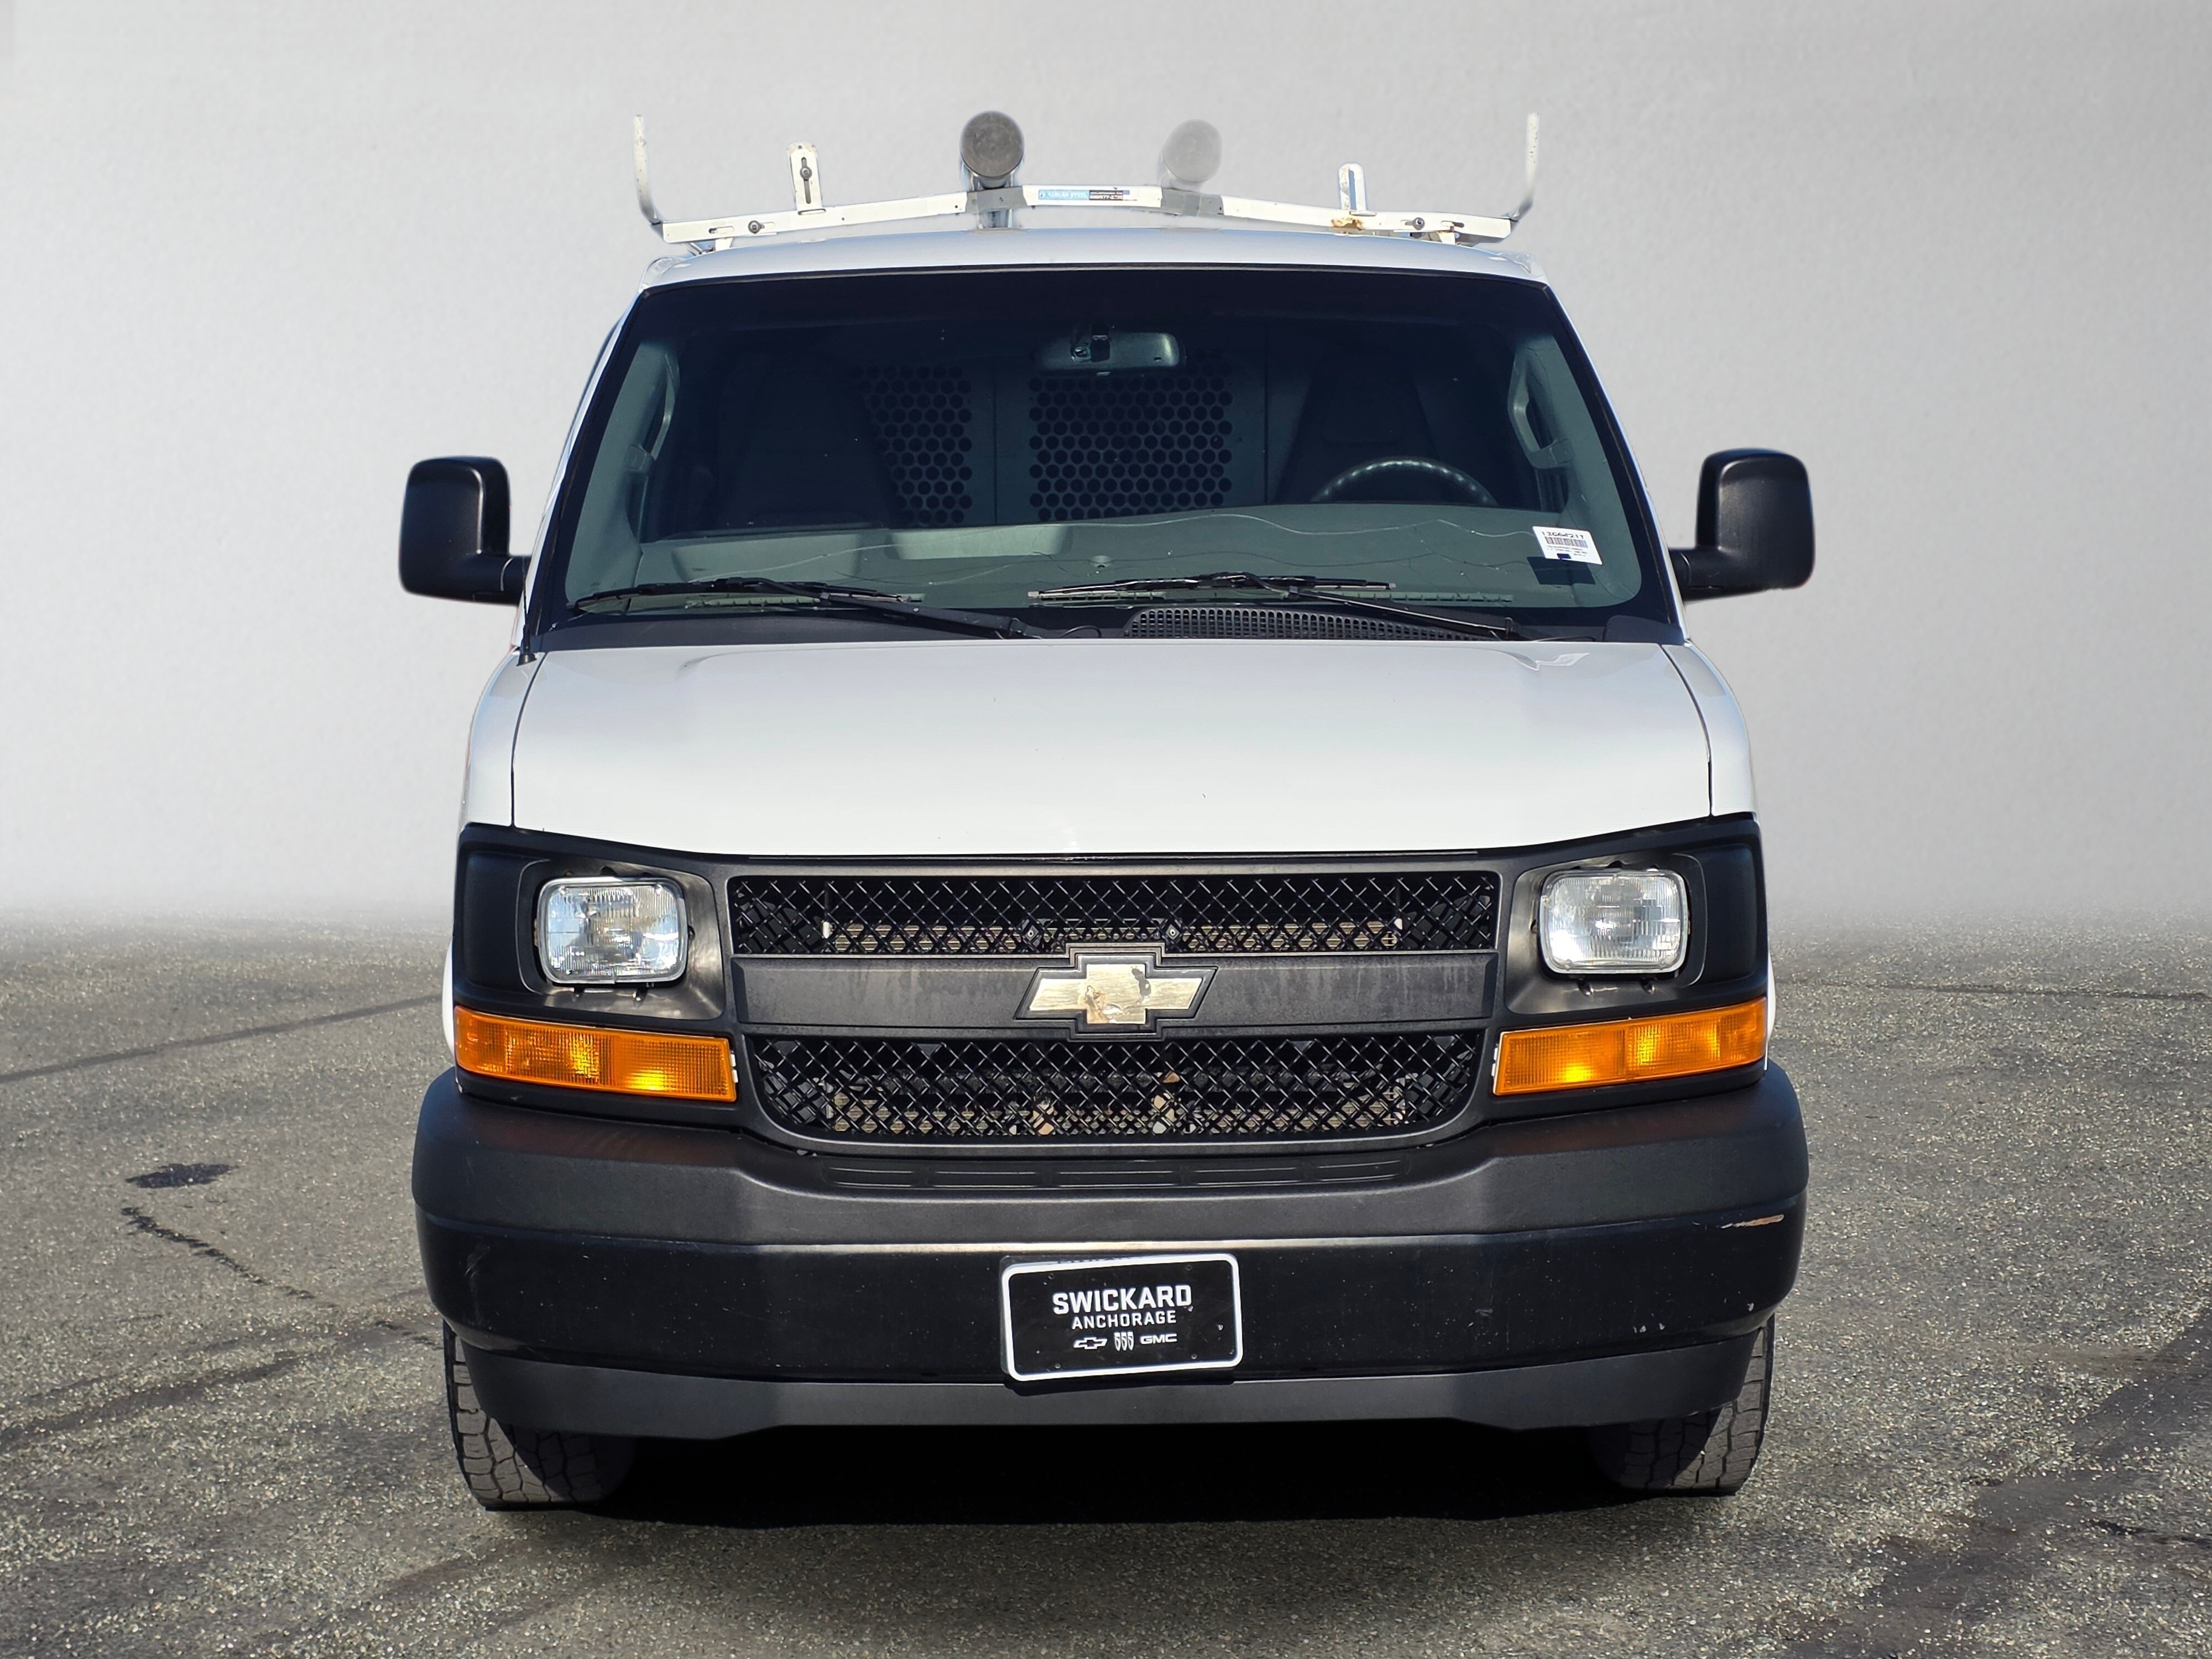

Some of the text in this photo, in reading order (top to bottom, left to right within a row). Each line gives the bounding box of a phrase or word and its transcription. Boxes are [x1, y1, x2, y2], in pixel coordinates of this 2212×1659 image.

[1052, 1285, 1192, 1315] SWICKARD
[1072, 1310, 1177, 1330] ANCHORAGE
[1140, 1333, 1177, 1345] GMC
